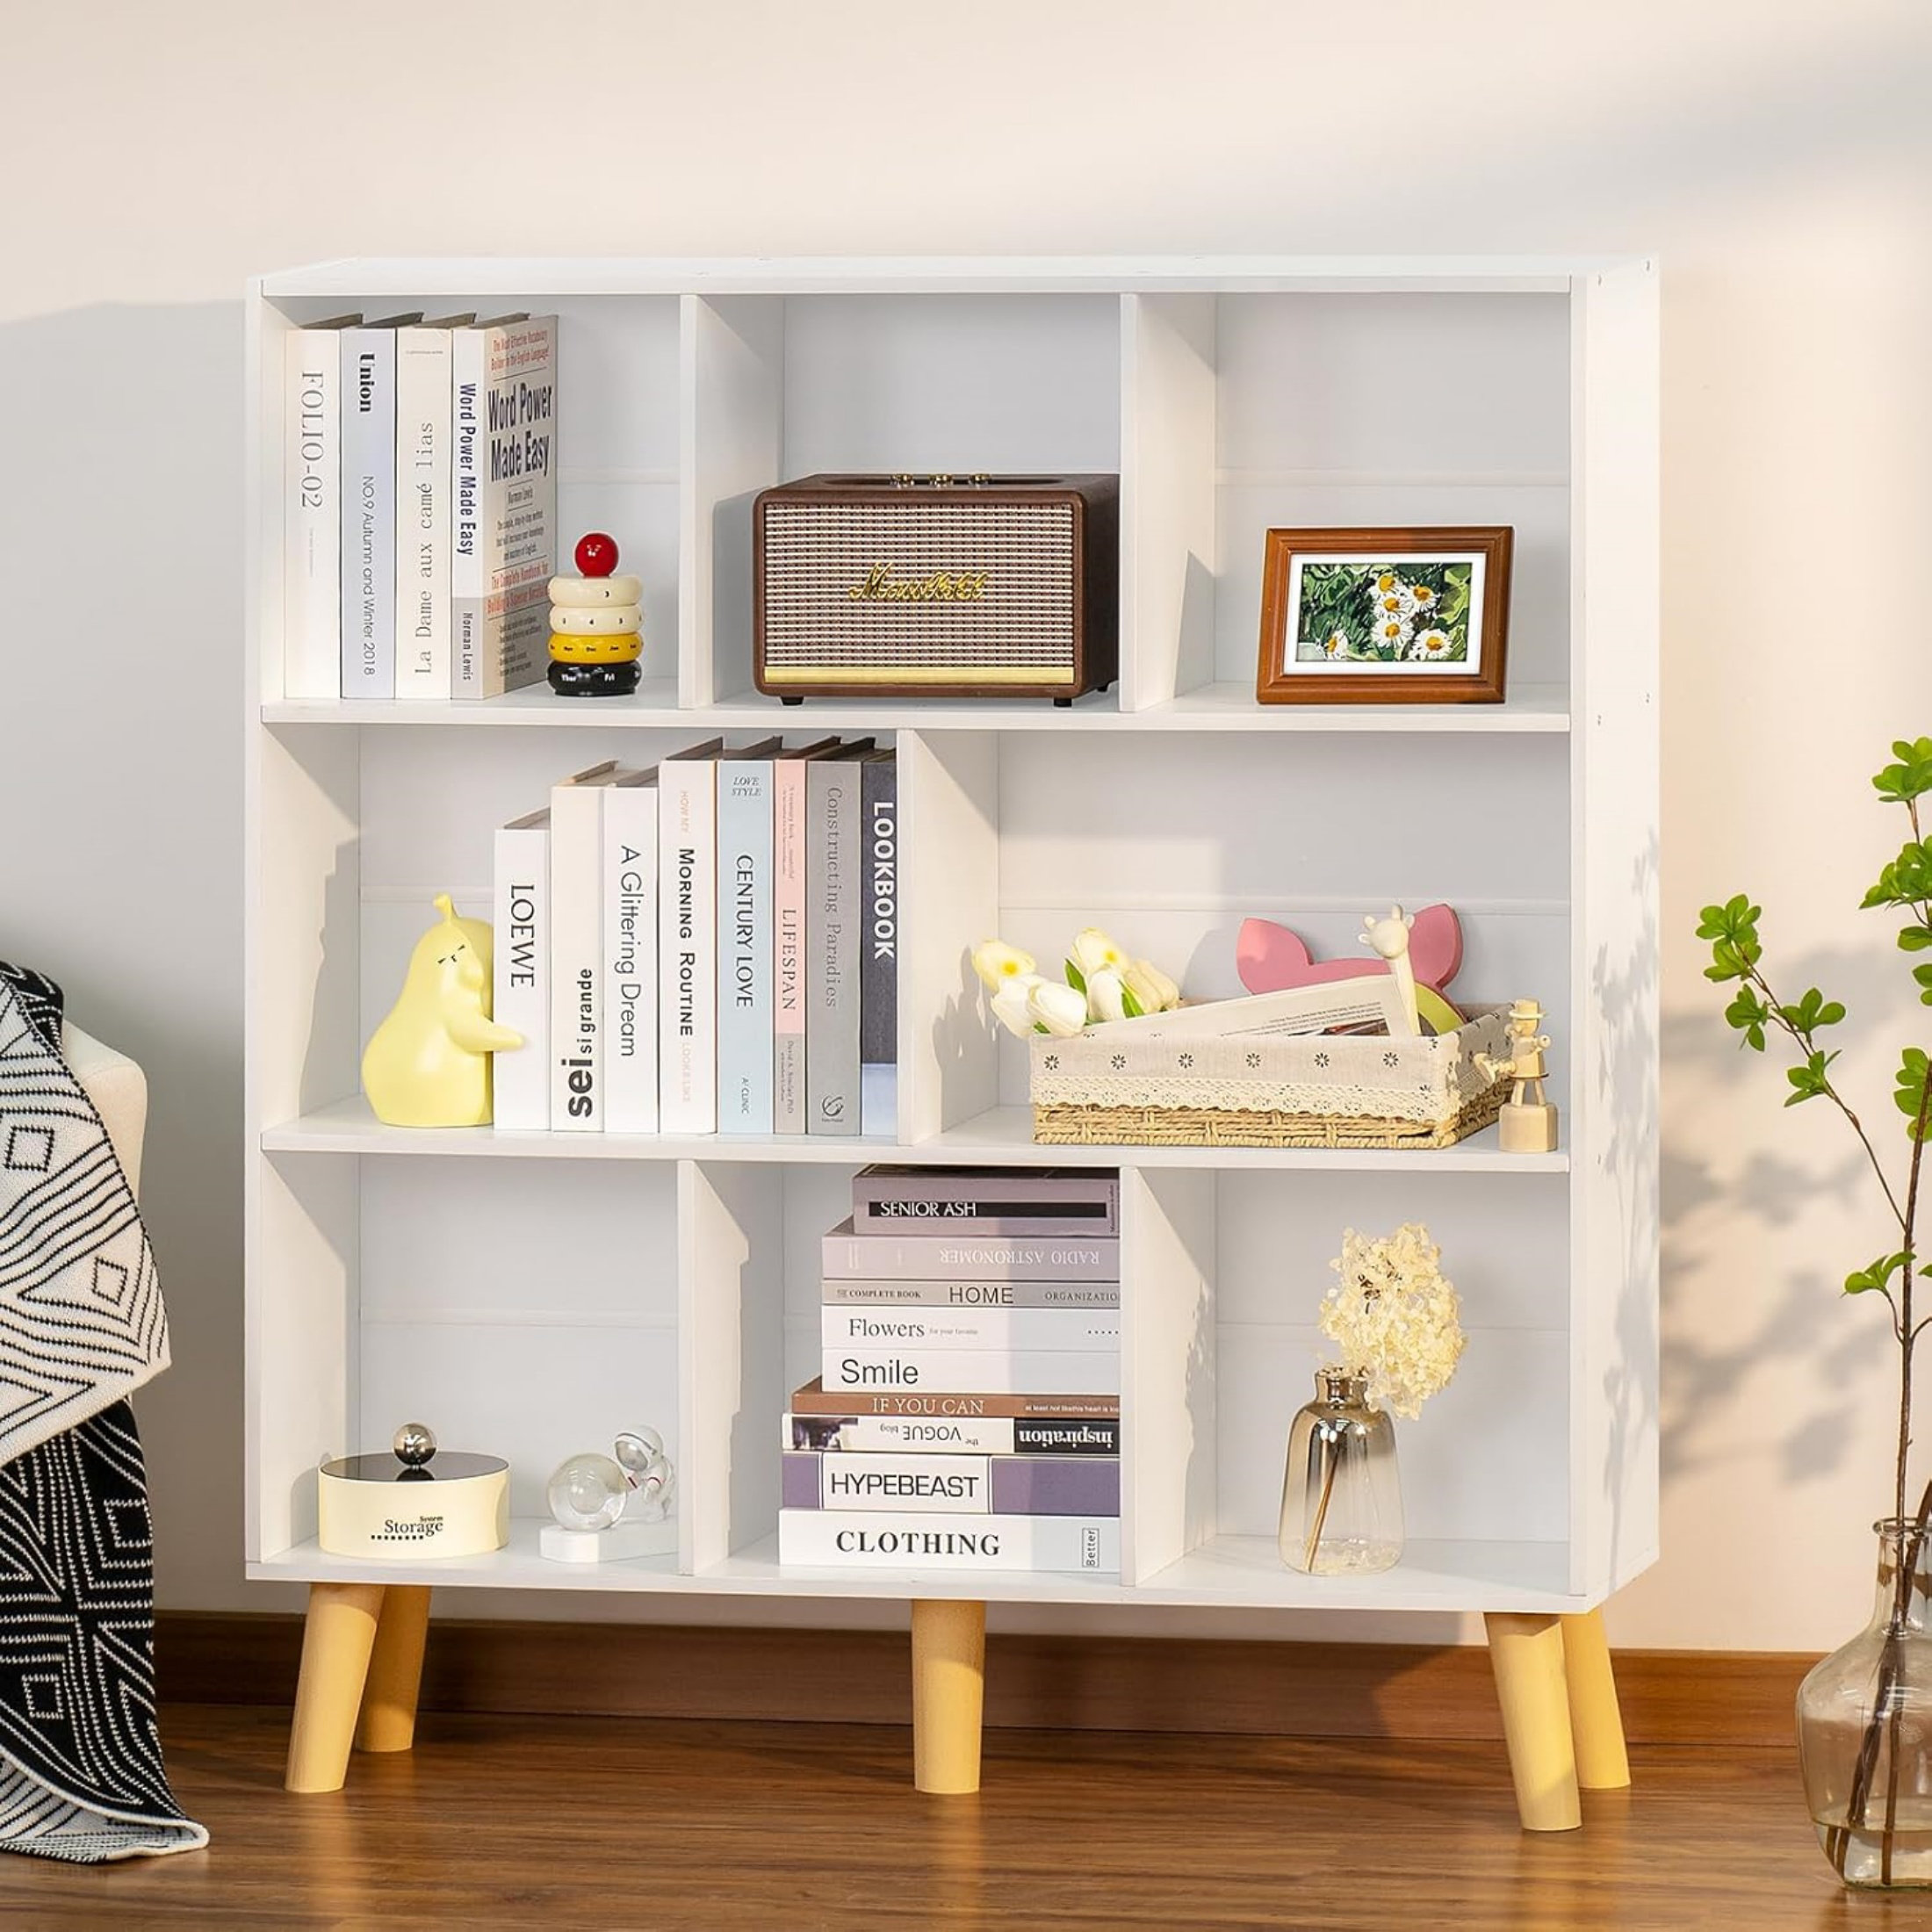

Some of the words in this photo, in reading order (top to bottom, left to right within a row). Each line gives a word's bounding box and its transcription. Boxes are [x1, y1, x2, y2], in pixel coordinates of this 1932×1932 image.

[360, 353, 376, 413] Union
[459, 383, 475, 420] Word
[488, 384, 516, 432] Word
[520, 383, 552, 424] Power
[301, 372, 324, 508] FOLIO-02
[415, 422, 433, 469] lias
[459, 426, 475, 472] Power
[492, 434, 522, 481] Made
[525, 430, 550, 476] Easy
[416, 483, 432, 529] camé
[459, 477, 475, 516] Made
[363, 513, 376, 565] Autumn
[457, 523, 475, 556] Easy
[421, 543, 432, 578] aux
[363, 567, 376, 595] and
[363, 598, 376, 638] Winter
[415, 590, 432, 638] Dame
[463, 613, 473, 650] Norman
[364, 643, 375, 675] 2018
[415, 650, 431, 674] La
[463, 653, 473, 681] Lewis
[732, 787, 761, 797] STYLE
[733, 776, 760, 786] LOVE
[621, 845, 642, 864] A
[825, 788, 843, 913] Constructing
[679, 848, 695, 940] MORNING
[874, 802, 895, 960] LOOKBOOK
[736, 854, 753, 950] CENTURY
[511, 884, 535, 988] LOEWE
[615, 871, 644, 975] Glittering
[782, 909, 797, 1010] LIFESPAN
[826, 924, 841, 1007] Paradies
[680, 952, 695, 1036] ROUTINE
[736, 956, 753, 1007] LOVE
[577, 969, 596, 1033] grande
[620, 984, 642, 1056] Dream
[577, 1039, 593, 1054] si
[561, 1058, 593, 1118] sei
[880, 1201, 940, 1217] SENIOR
[944, 1201, 977, 1217] ASH
[940, 1248, 1044, 1265] ASTRONOMER
[1050, 1250, 1099, 1265] RADIO
[849, 1289, 894, 1298] COMPLETE
[898, 1289, 922, 1299] BOOK
[949, 1287, 1013, 1304] HOME
[1045, 1291, 1119, 1301] ORGANIZATIO
[849, 1318, 925, 1337] Flowers
[840, 1359, 919, 1384] Smile
[873, 1397, 890, 1413] IF
[895, 1398, 936, 1413] YOU
[941, 1399, 985, 1415] CAN
[880, 1423, 898, 1434] blog
[903, 1426, 962, 1441] VOGUE
[1019, 1426, 1114, 1448] inspiration
[831, 1473, 979, 1497] HYPEBEAST
[385, 1518, 443, 1537] Storage
[836, 1530, 1000, 1556] CLOTHING
[1085, 1531, 1096, 1566] Better
